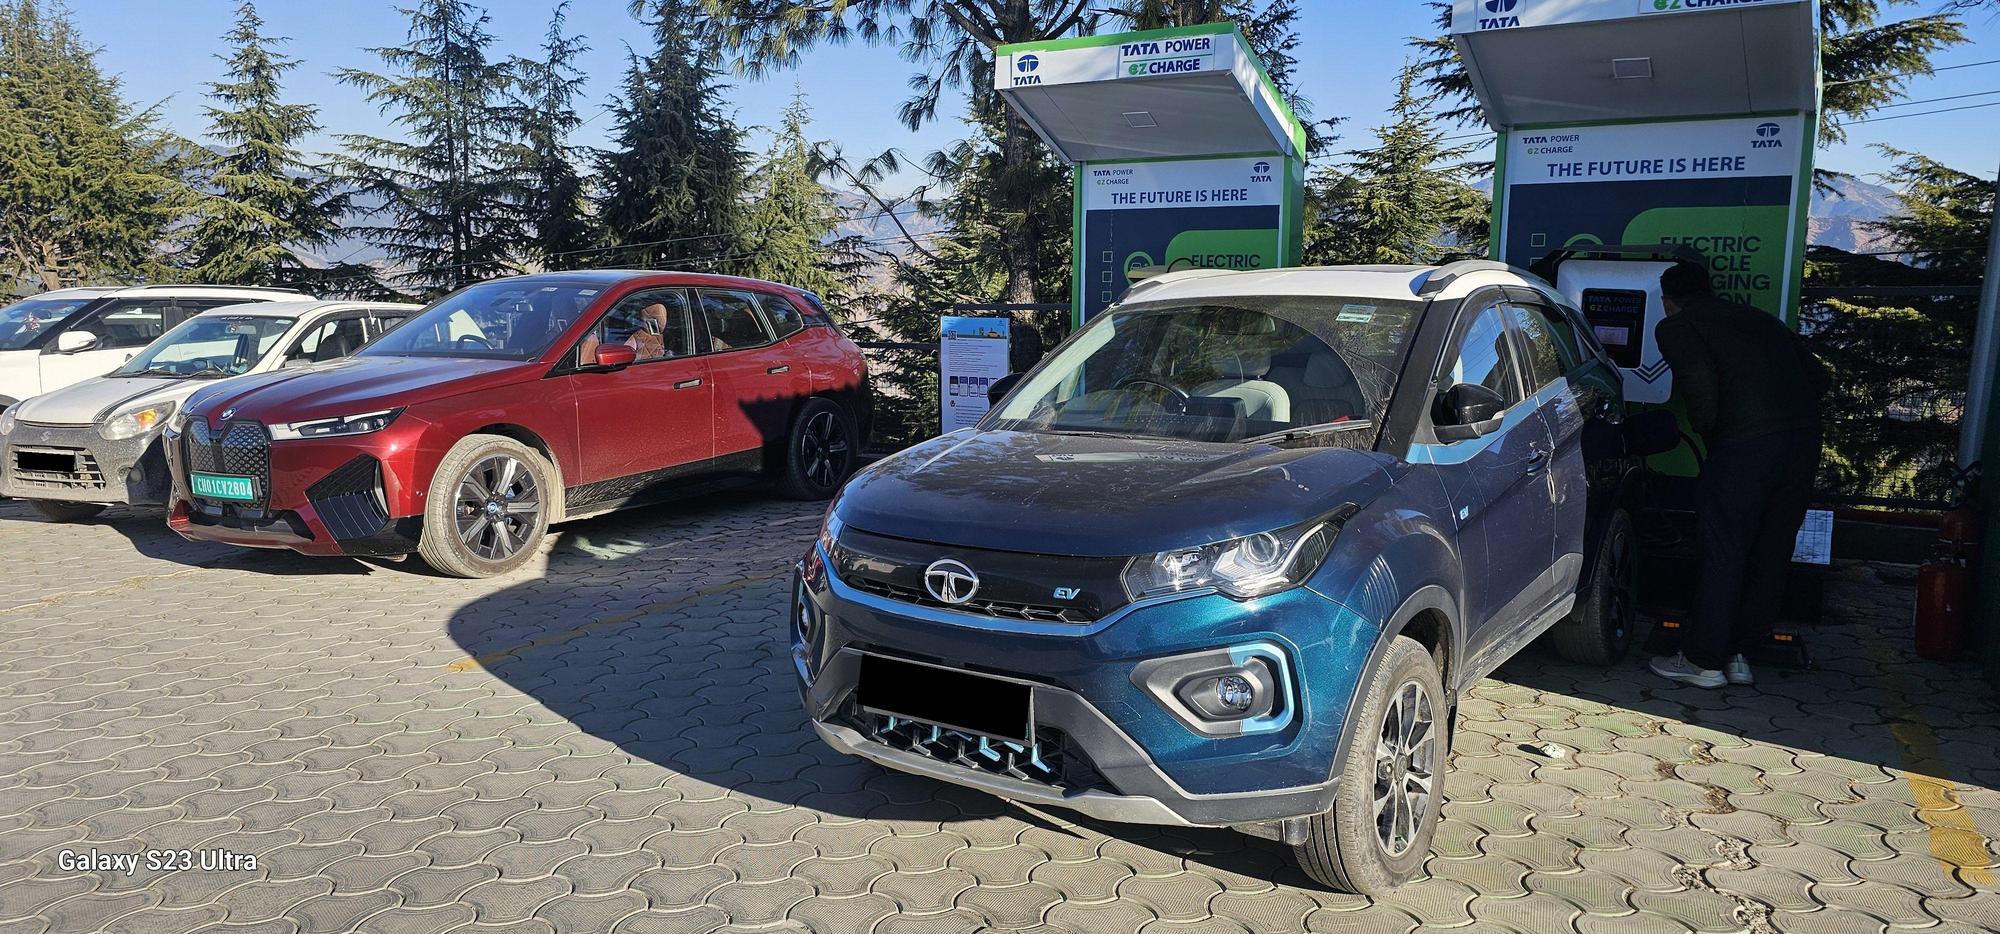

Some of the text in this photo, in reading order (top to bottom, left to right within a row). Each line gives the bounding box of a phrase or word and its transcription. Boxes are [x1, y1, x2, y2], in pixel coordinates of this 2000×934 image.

[1479, 16, 1520, 29] TATA
[1122, 38, 1210, 56] TATA POWER
[1150, 59, 1200, 74] CHARGE
[1013, 75, 1042, 85] TATA
[1550, 134, 1580, 143] POWER
[1751, 140, 1782, 148] TATA
[1540, 146, 1573, 154] CHARGE
[1547, 156, 1745, 177] THE FUTURE IS HERE
[1250, 175, 1272, 183] TATA
[1112, 189, 1248, 205] THE FUTURE IS HERE
[1191, 254, 1261, 268] ELECTRIC
[1053, 587, 1080, 600] EV
